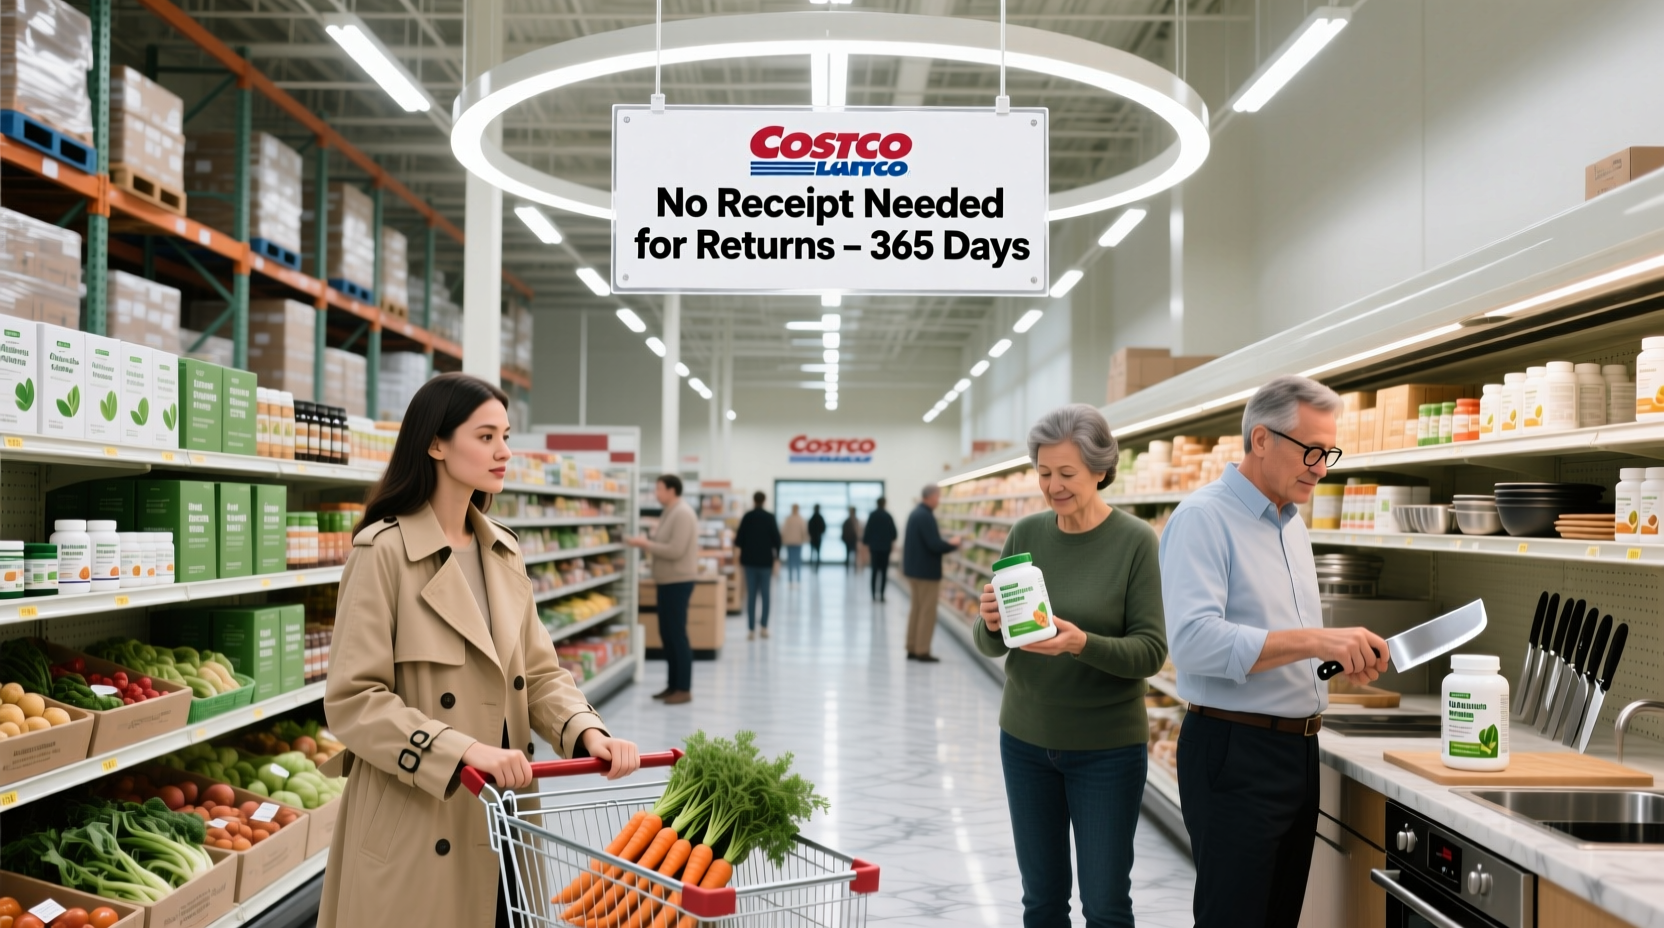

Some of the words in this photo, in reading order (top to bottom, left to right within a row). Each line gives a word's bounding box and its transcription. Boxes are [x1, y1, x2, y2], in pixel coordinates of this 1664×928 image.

[750, 126, 912, 159] COSTCO
[657, 187, 708, 218] No
[717, 186, 854, 226] Receipt
[864, 187, 1004, 218] Needed
[634, 228, 688, 260] for
[696, 230, 836, 261] Returns
[870, 230, 934, 261] 365
[943, 230, 1031, 269] Days
